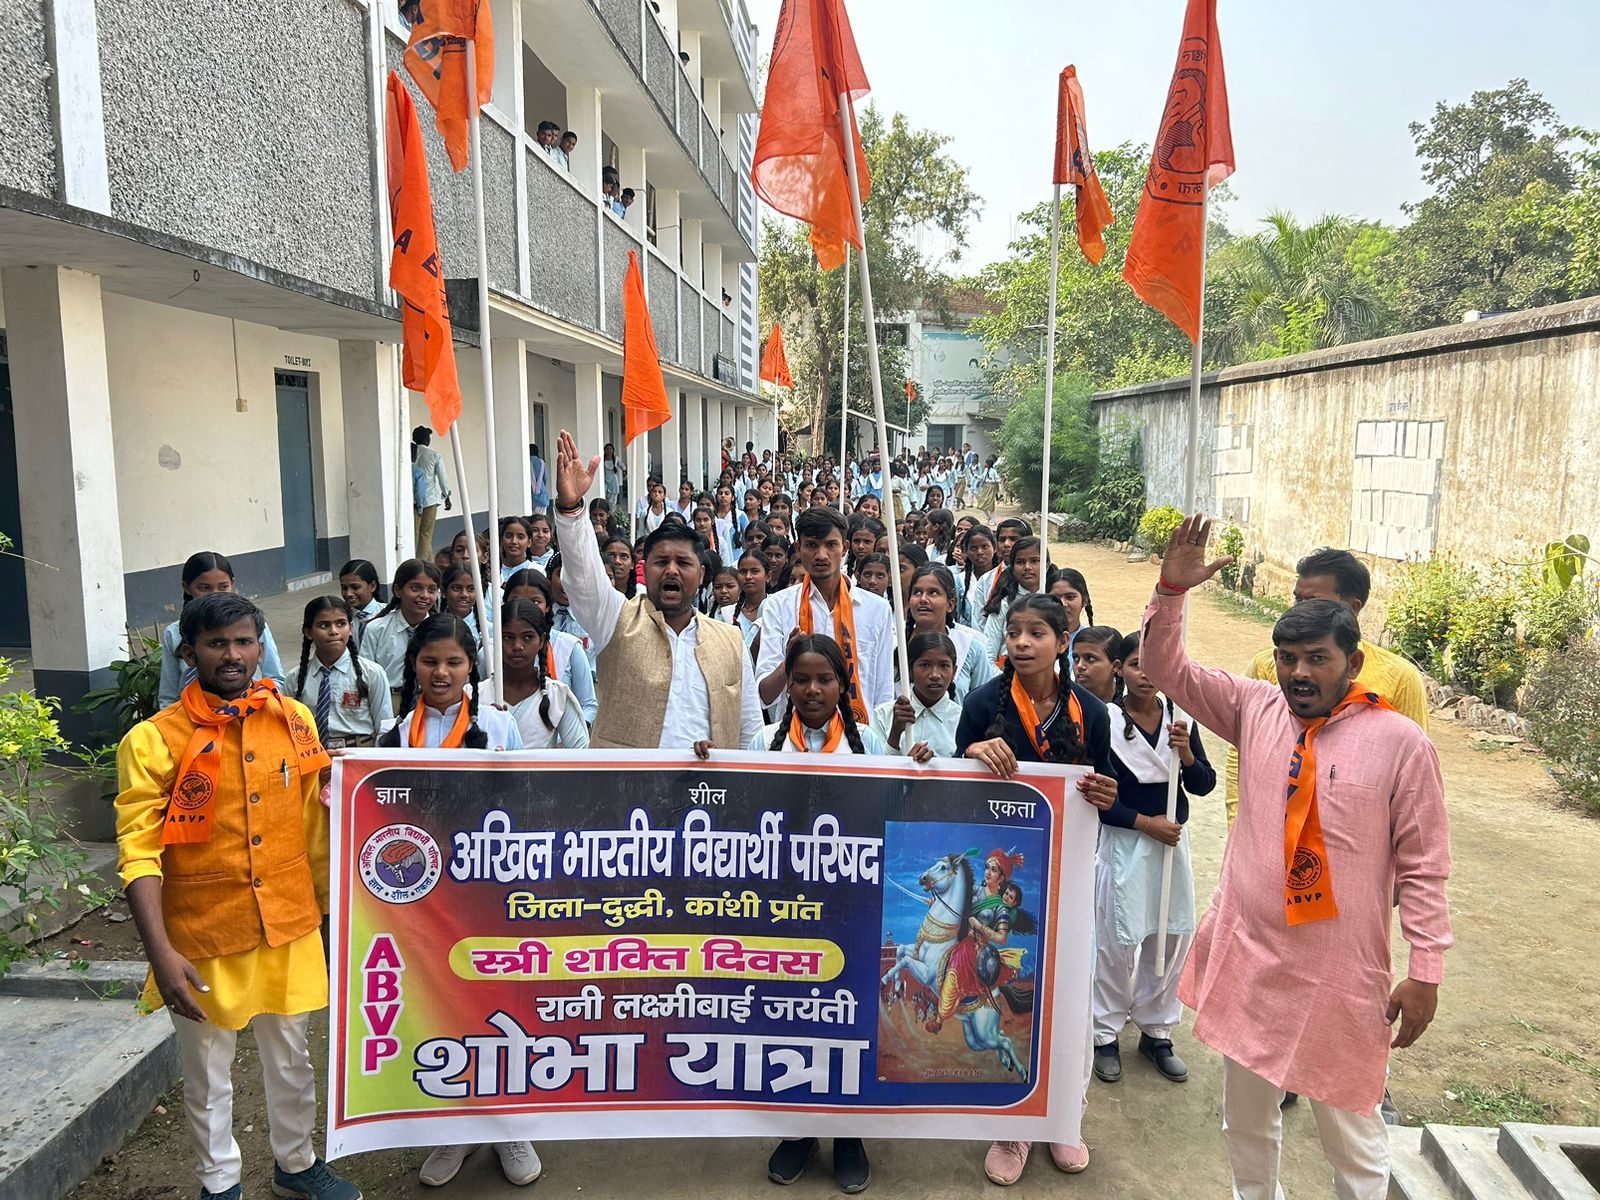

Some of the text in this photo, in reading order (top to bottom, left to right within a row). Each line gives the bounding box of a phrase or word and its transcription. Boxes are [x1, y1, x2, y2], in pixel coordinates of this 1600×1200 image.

[375, 786, 411, 805] ज्ञान
[689, 782, 727, 805] शील
[988, 799, 1036, 820] एकता
[169, 814, 206, 823] ABVP
[450, 807, 883, 885] अखिल भारतीय विद्यार्थी परिषद
[685, 890, 762, 919] कांशी
[769, 894, 824, 923] प्रांत
[471, 937, 823, 975] स्त्री शक्ति दिवस
[362, 934, 403, 1074] ABVP
[536, 983, 858, 1024] रानी लक्ष्मीबाई जयंती
[415, 1011, 870, 1097] शोभा यात्रा
